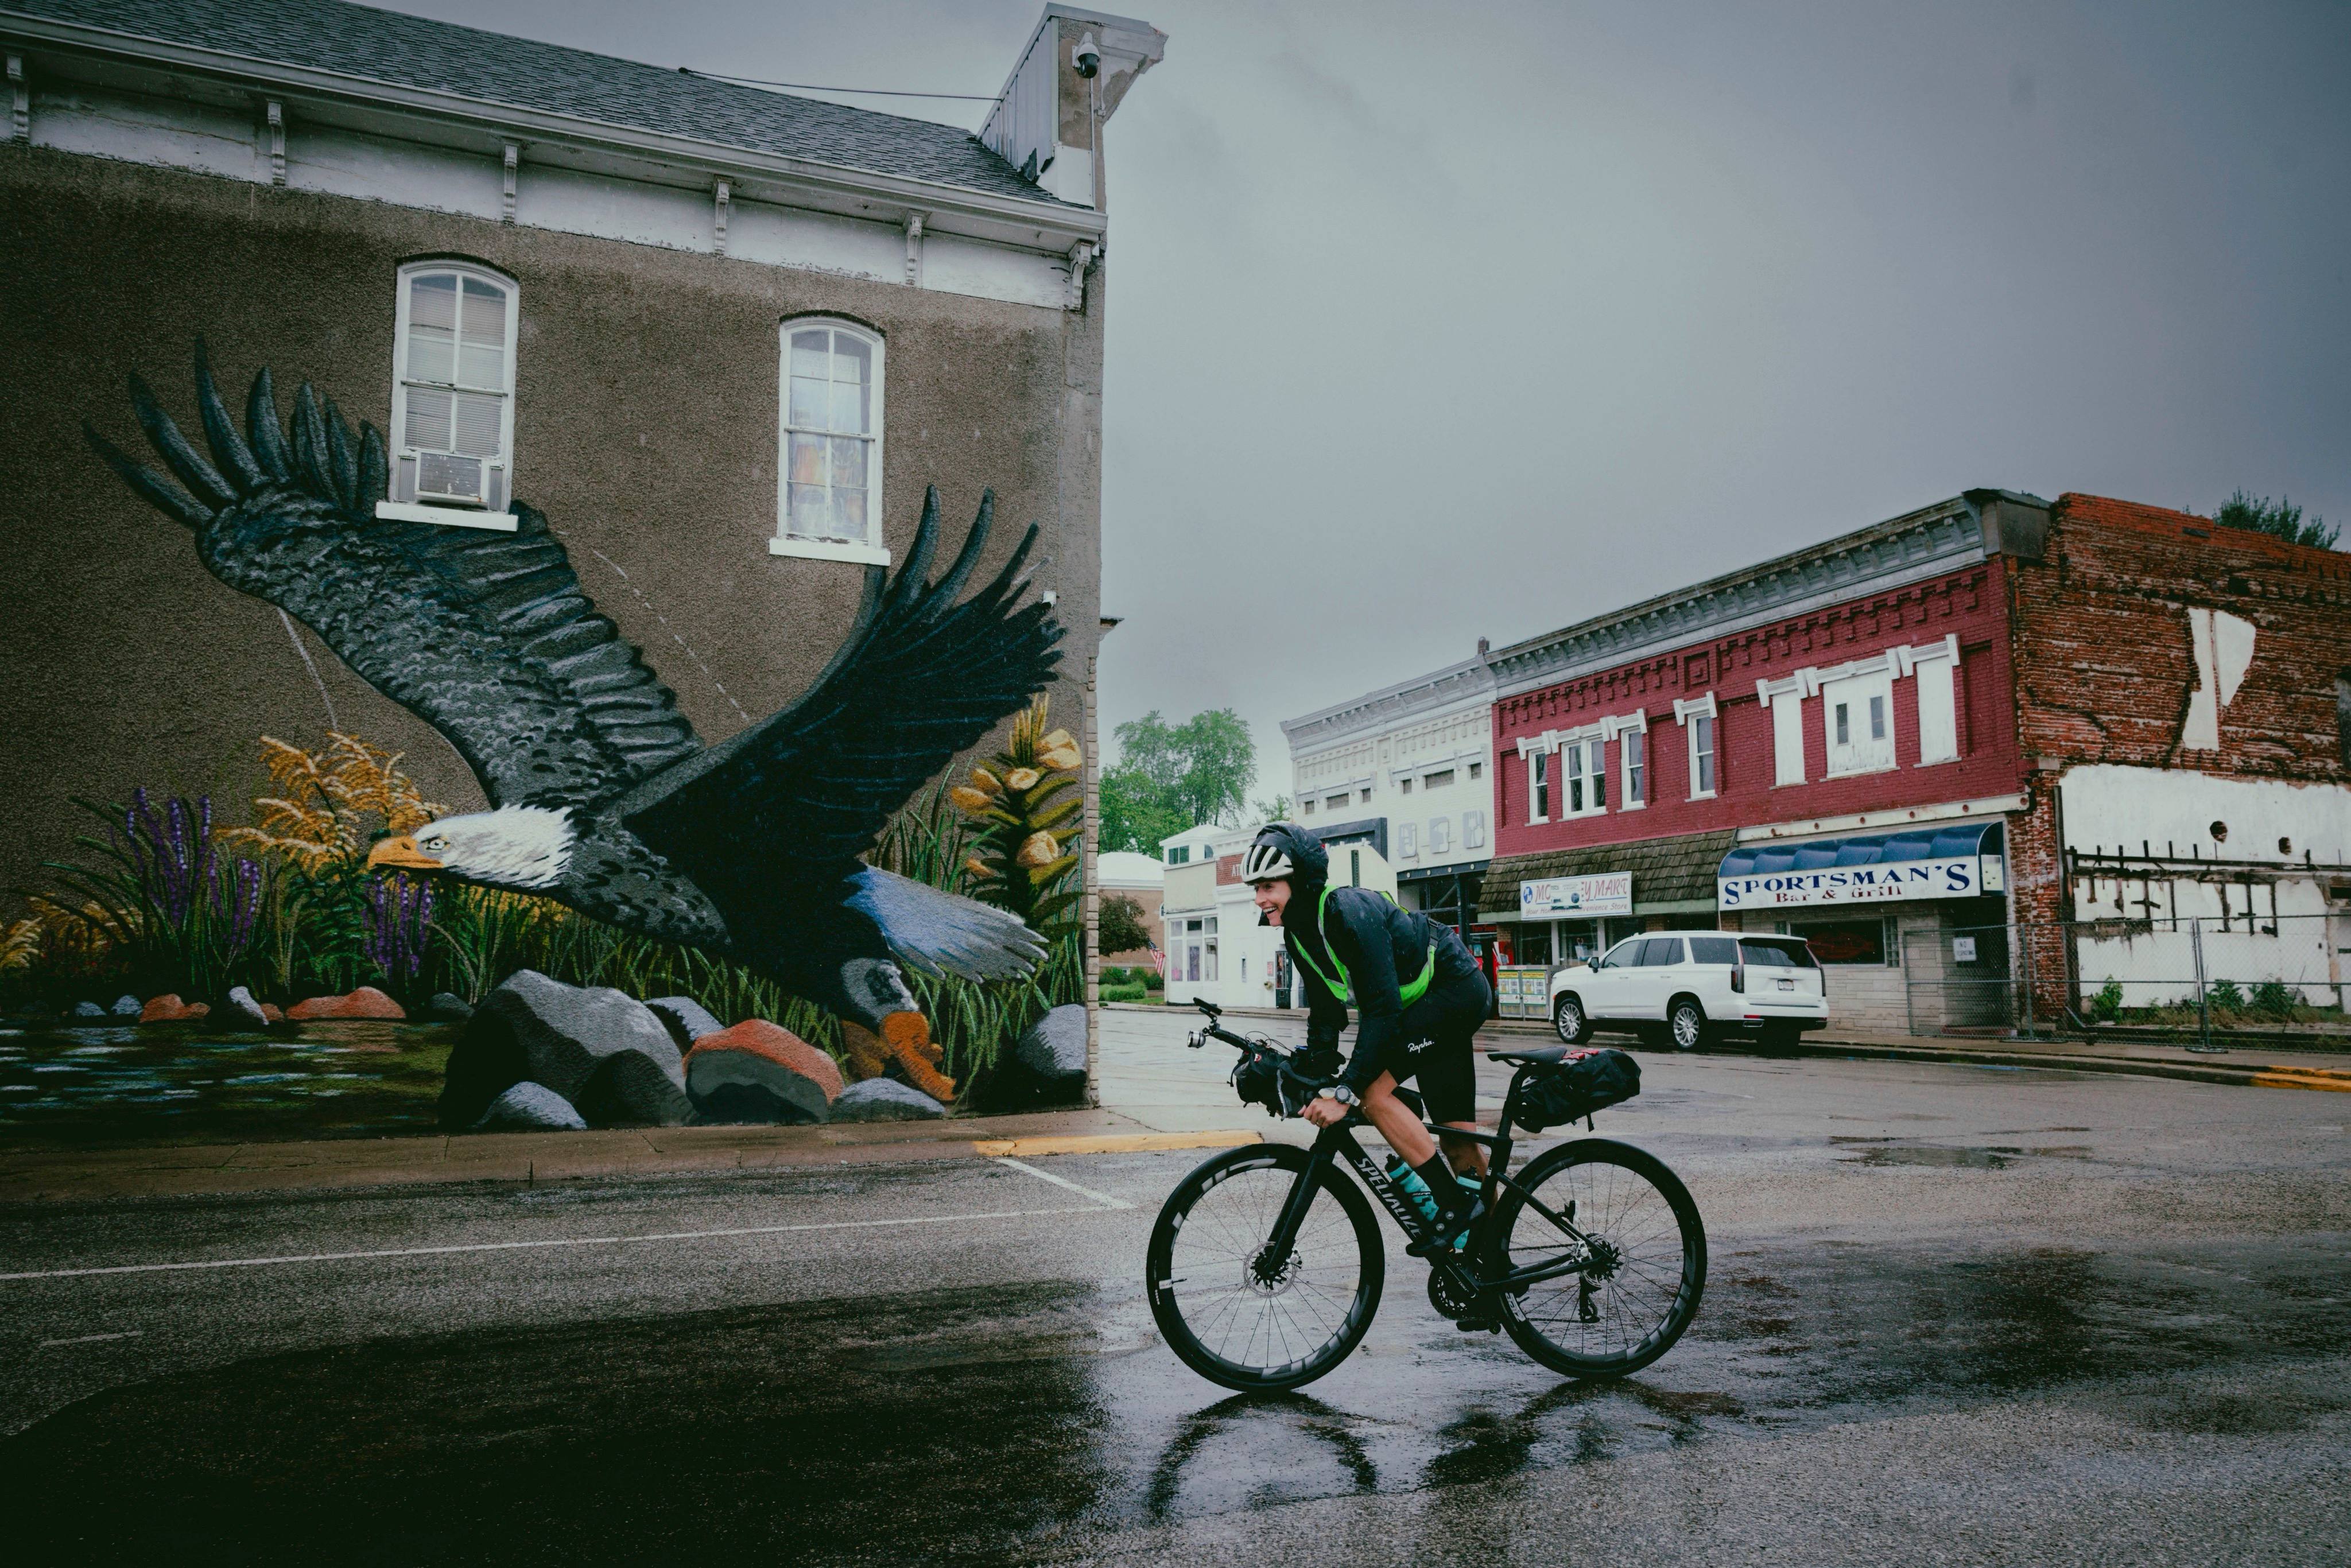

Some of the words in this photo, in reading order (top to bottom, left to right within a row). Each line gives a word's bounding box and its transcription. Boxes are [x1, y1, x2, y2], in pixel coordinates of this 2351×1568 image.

[1594, 878, 1628, 899] MART
[1724, 863, 1970, 905] SPORTSMAN'S
[1776, 892, 1810, 903] Bar
[1822, 890, 1837, 899] &
[1851, 886, 1902, 898] Grill
[1525, 908, 1539, 917] Your
[1353, 1157, 1423, 1238] SPECIALIZE
